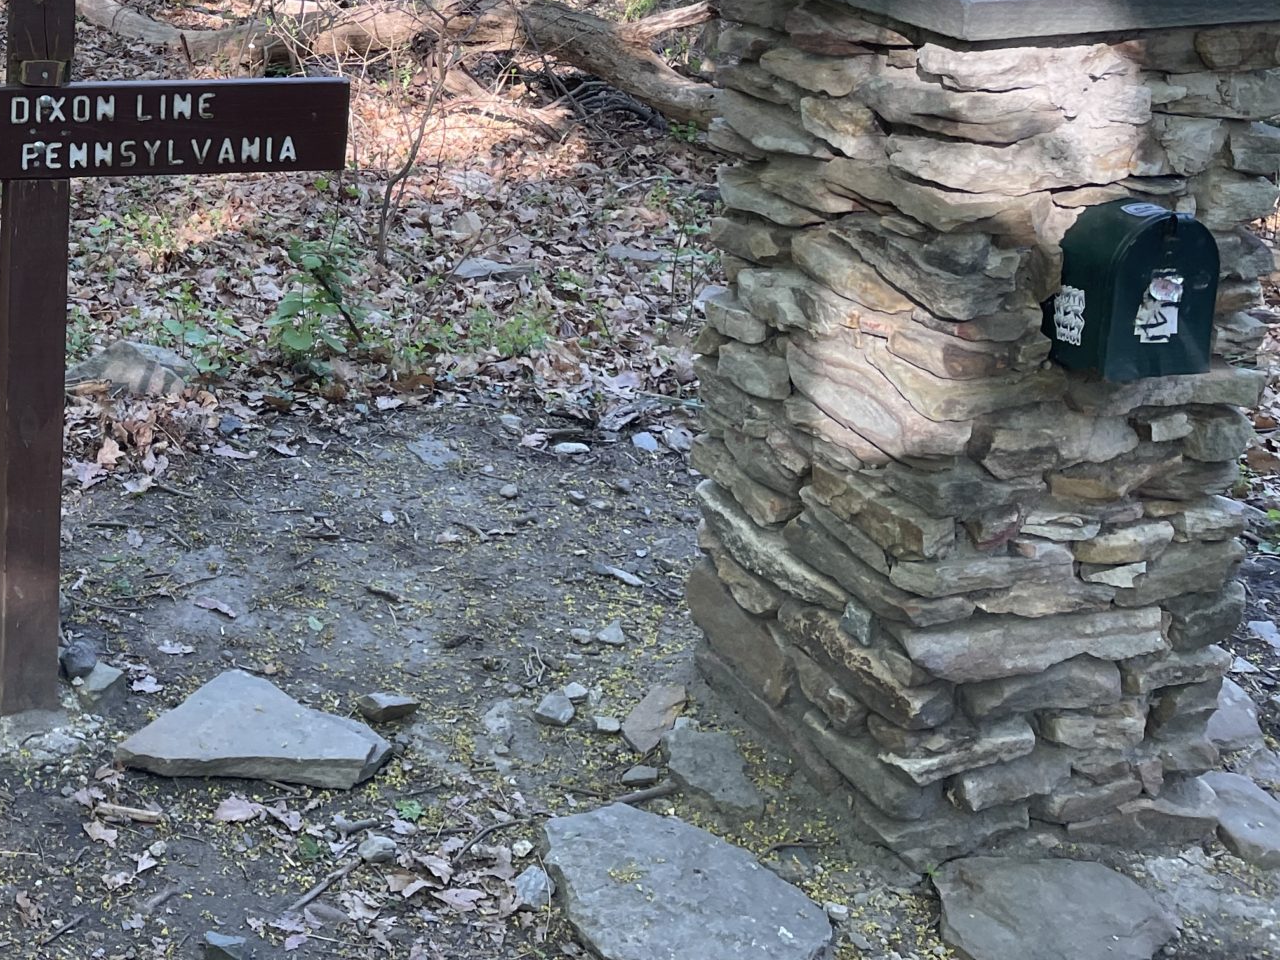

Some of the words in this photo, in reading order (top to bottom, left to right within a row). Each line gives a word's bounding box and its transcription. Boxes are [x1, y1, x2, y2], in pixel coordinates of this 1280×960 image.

[10, 94, 116, 125] DIXON
[137, 92, 216, 121] LINE
[21, 135, 297, 170] PENNSYLVANIA
